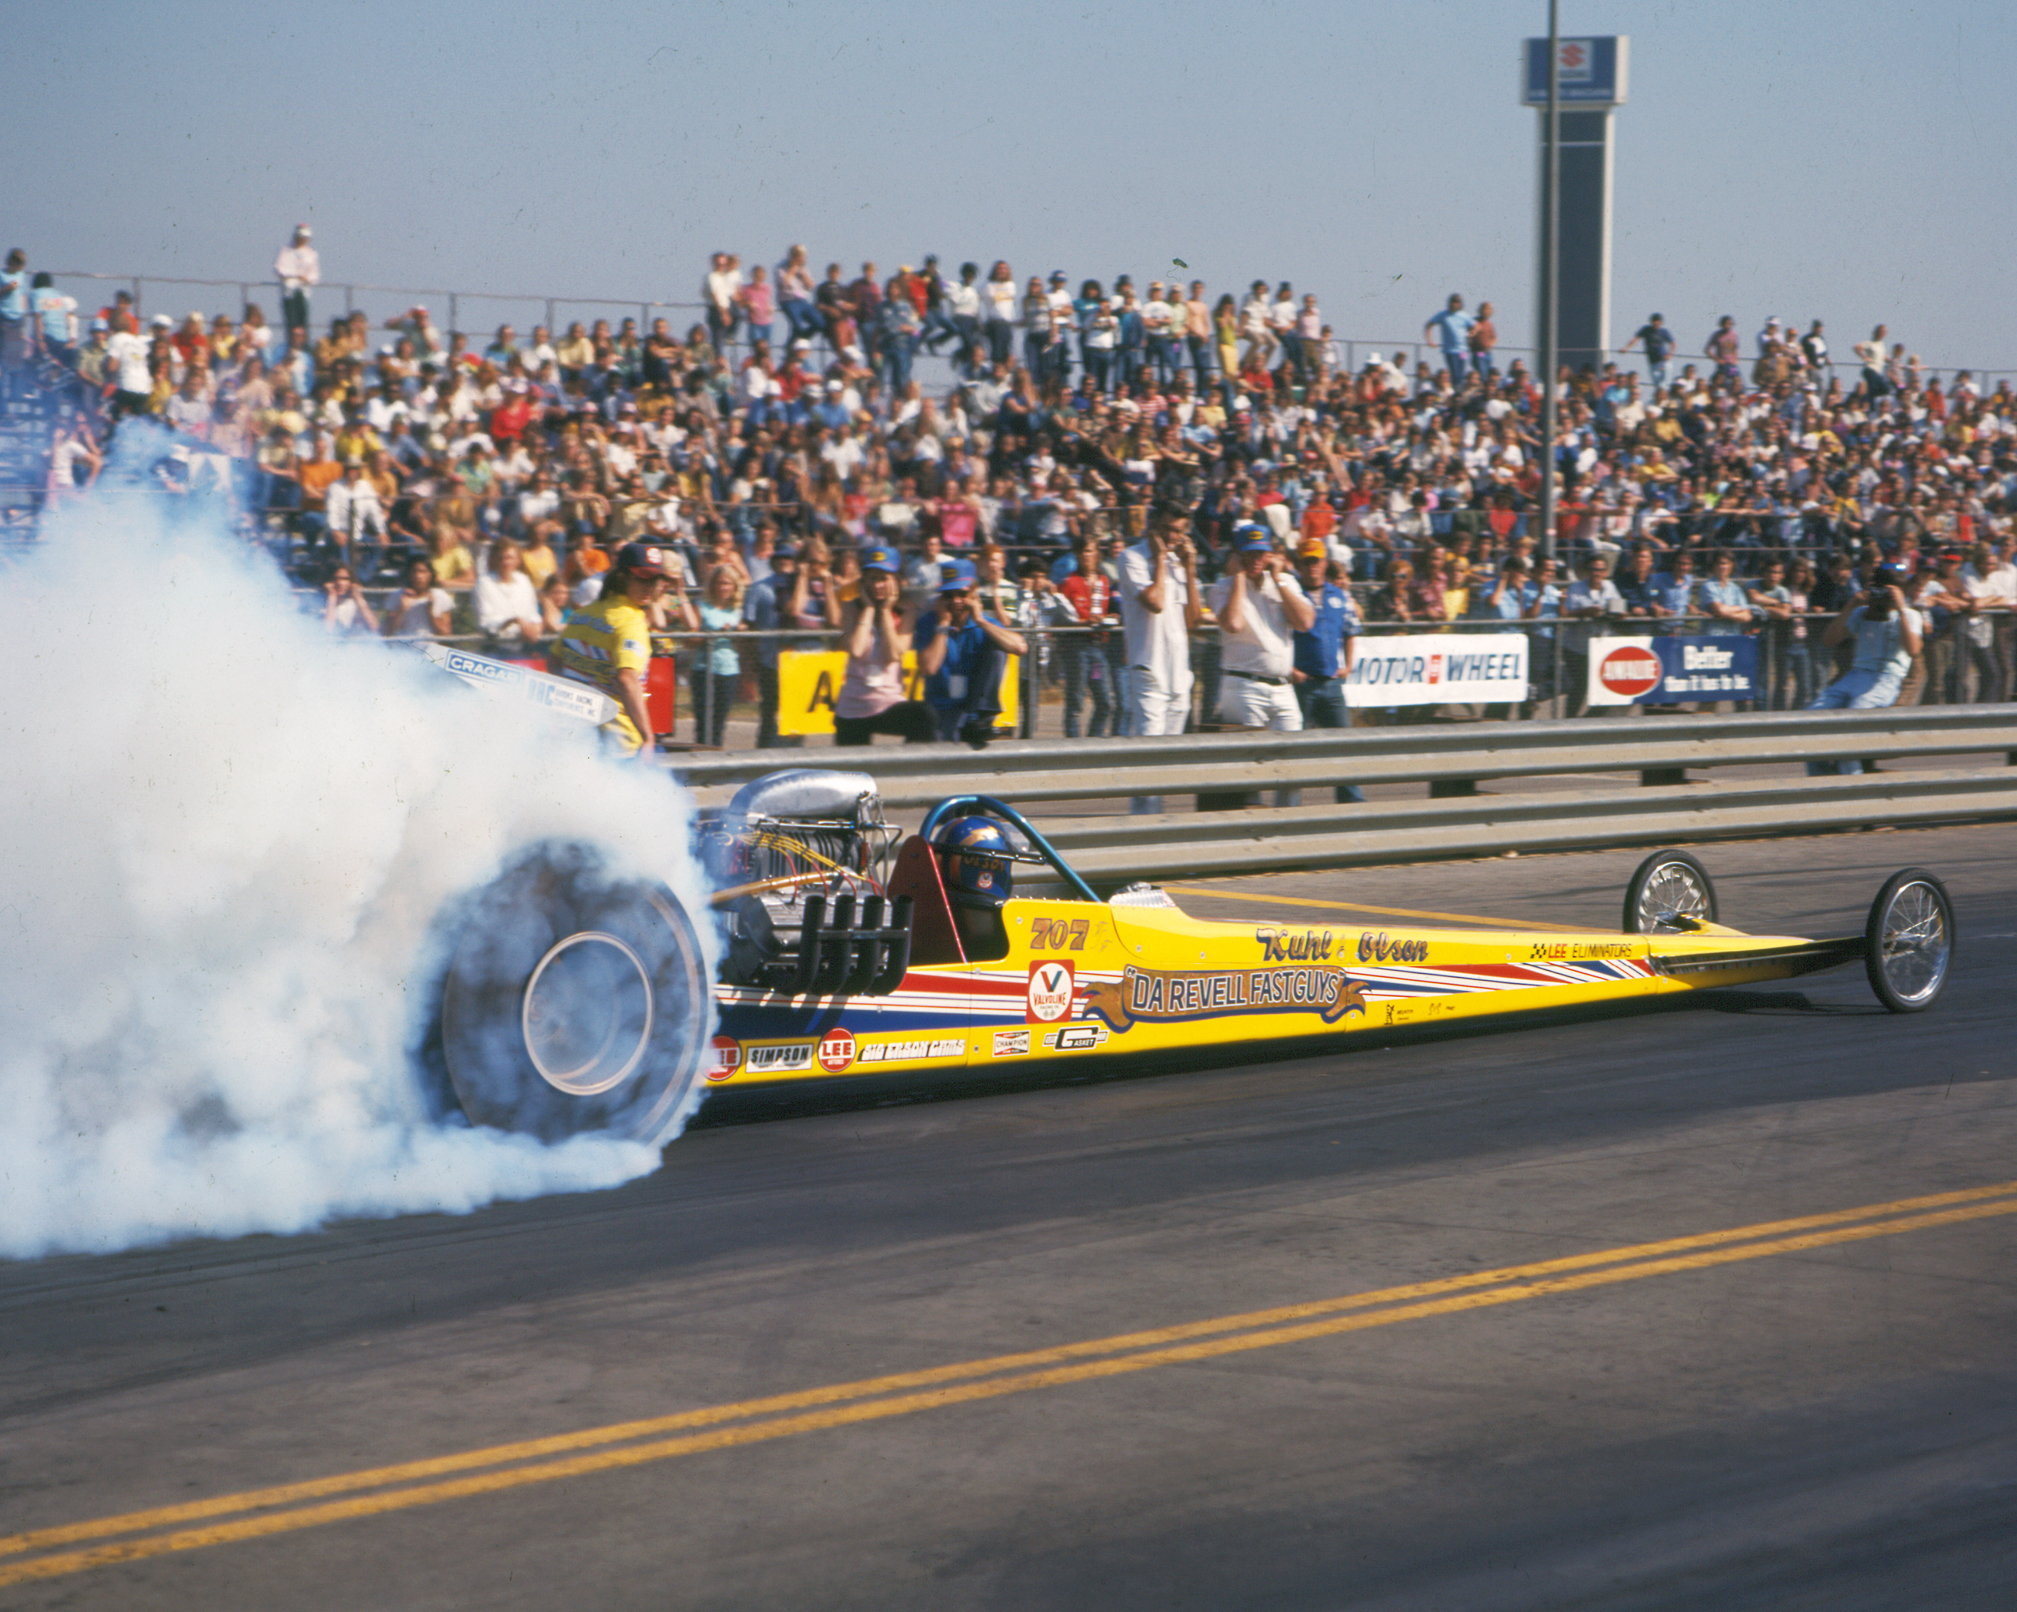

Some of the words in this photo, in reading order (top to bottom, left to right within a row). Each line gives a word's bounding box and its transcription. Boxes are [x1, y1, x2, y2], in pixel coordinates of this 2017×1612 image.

[1447, 653, 1521, 682] WHEEL
[1030, 917, 1090, 951] 707
[1256, 927, 1333, 962] Kuhl
[1359, 931, 1431, 963] Olson
[1548, 943, 1568, 958] LEE
[1572, 943, 1632, 958] ELIMINATORS
[1033, 992, 1067, 1007] VALVOLINE
[1168, 975, 1247, 1012] REVELL
[822, 1042, 852, 1057] LEE
[996, 1039, 1027, 1048] CHAMPION
[751, 1047, 810, 1064] SIMPSON
